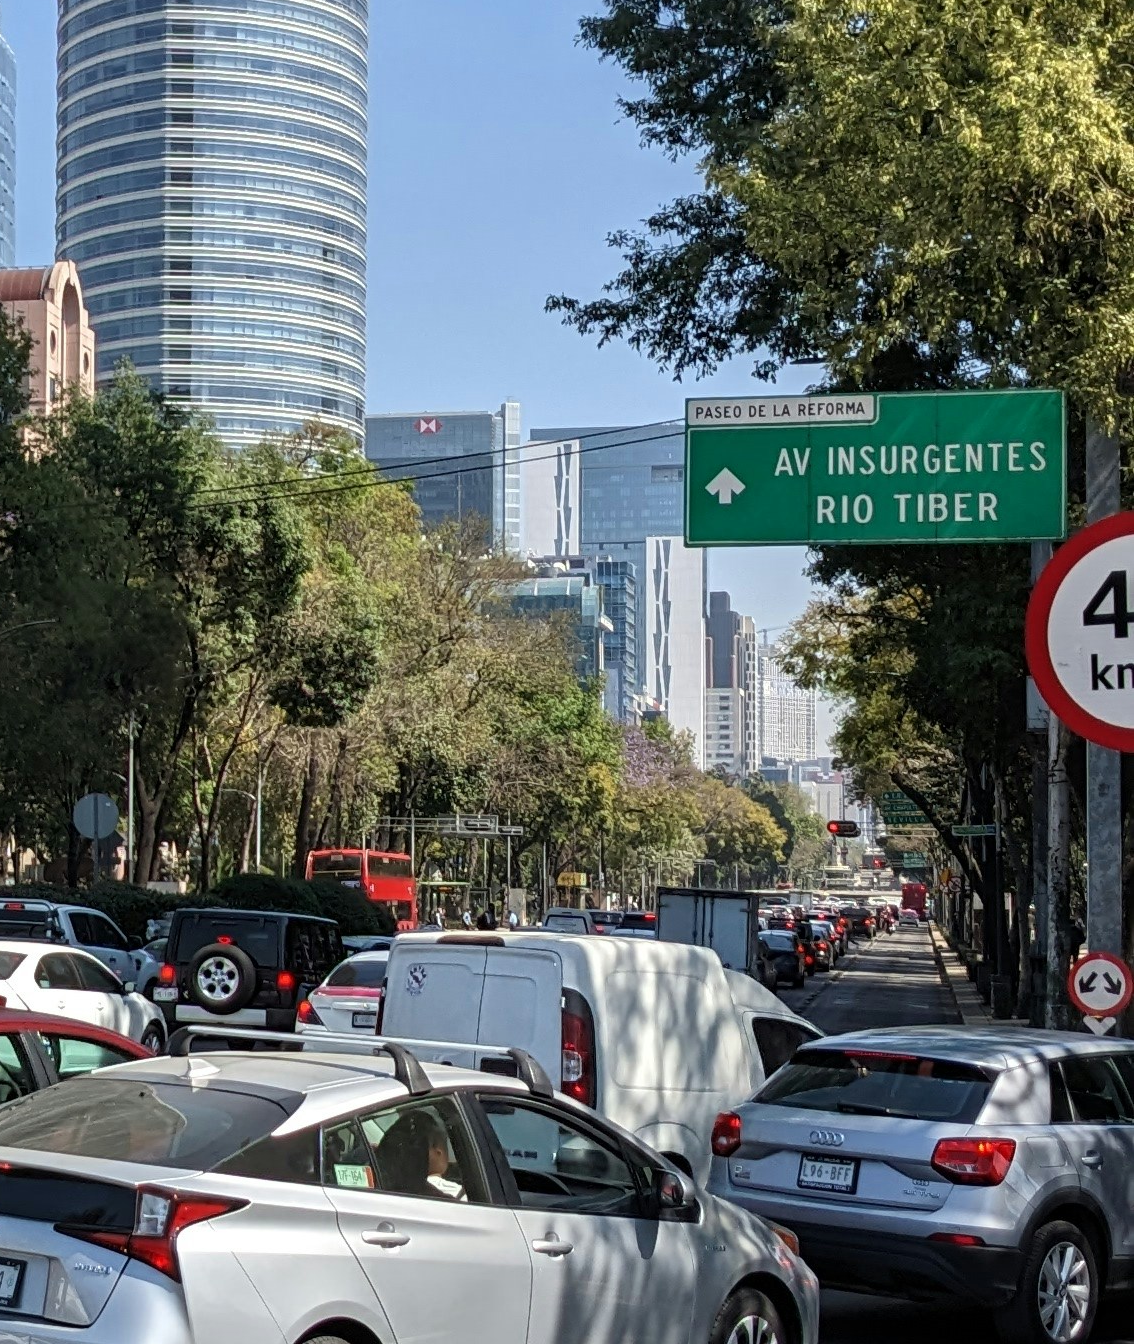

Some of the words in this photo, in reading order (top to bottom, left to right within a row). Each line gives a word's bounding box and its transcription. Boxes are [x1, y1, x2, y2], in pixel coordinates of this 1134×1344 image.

[695, 406, 742, 419] PASEO
[748, 405, 766, 418] DE
[773, 404, 791, 417] LA
[797, 402, 865, 416] REFORMA
[774, 447, 811, 477] AV
[827, 442, 1047, 476] INSURGENTES
[816, 494, 874, 524] RIO
[893, 492, 998, 523] TIBER
[1083, 570, 1134, 639] 4
[802, 1162, 852, 1182] L96-BFF
